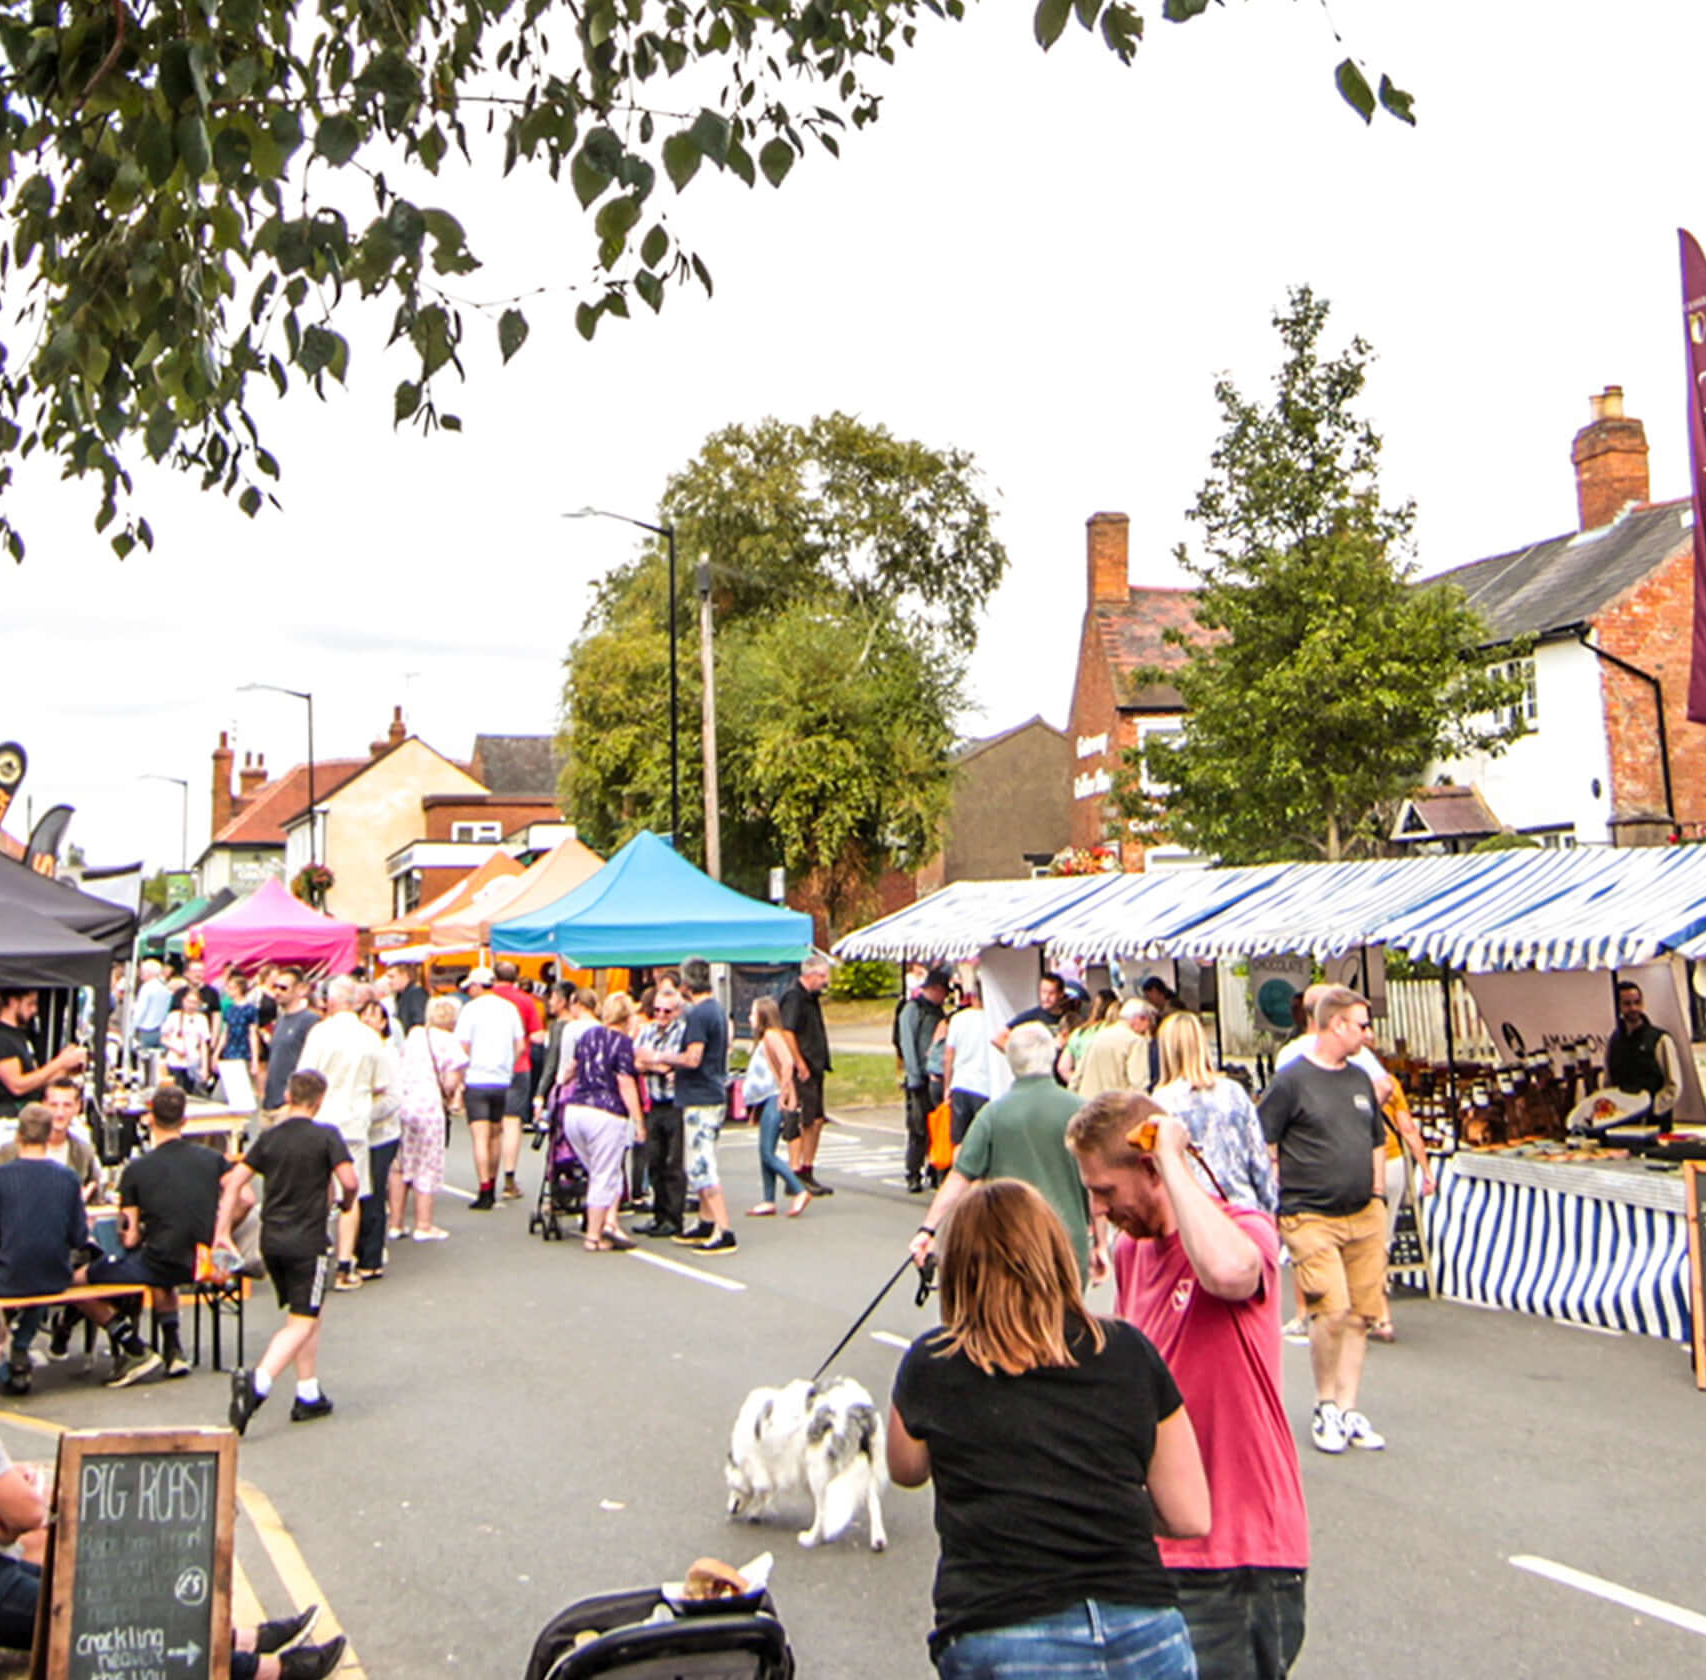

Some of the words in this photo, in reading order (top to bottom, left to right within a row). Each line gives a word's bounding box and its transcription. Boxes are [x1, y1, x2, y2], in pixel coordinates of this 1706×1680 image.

[80, 1462, 129, 1523] PIG
[138, 1459, 215, 1523] ROAST
[76, 1625, 165, 1661] crackling
